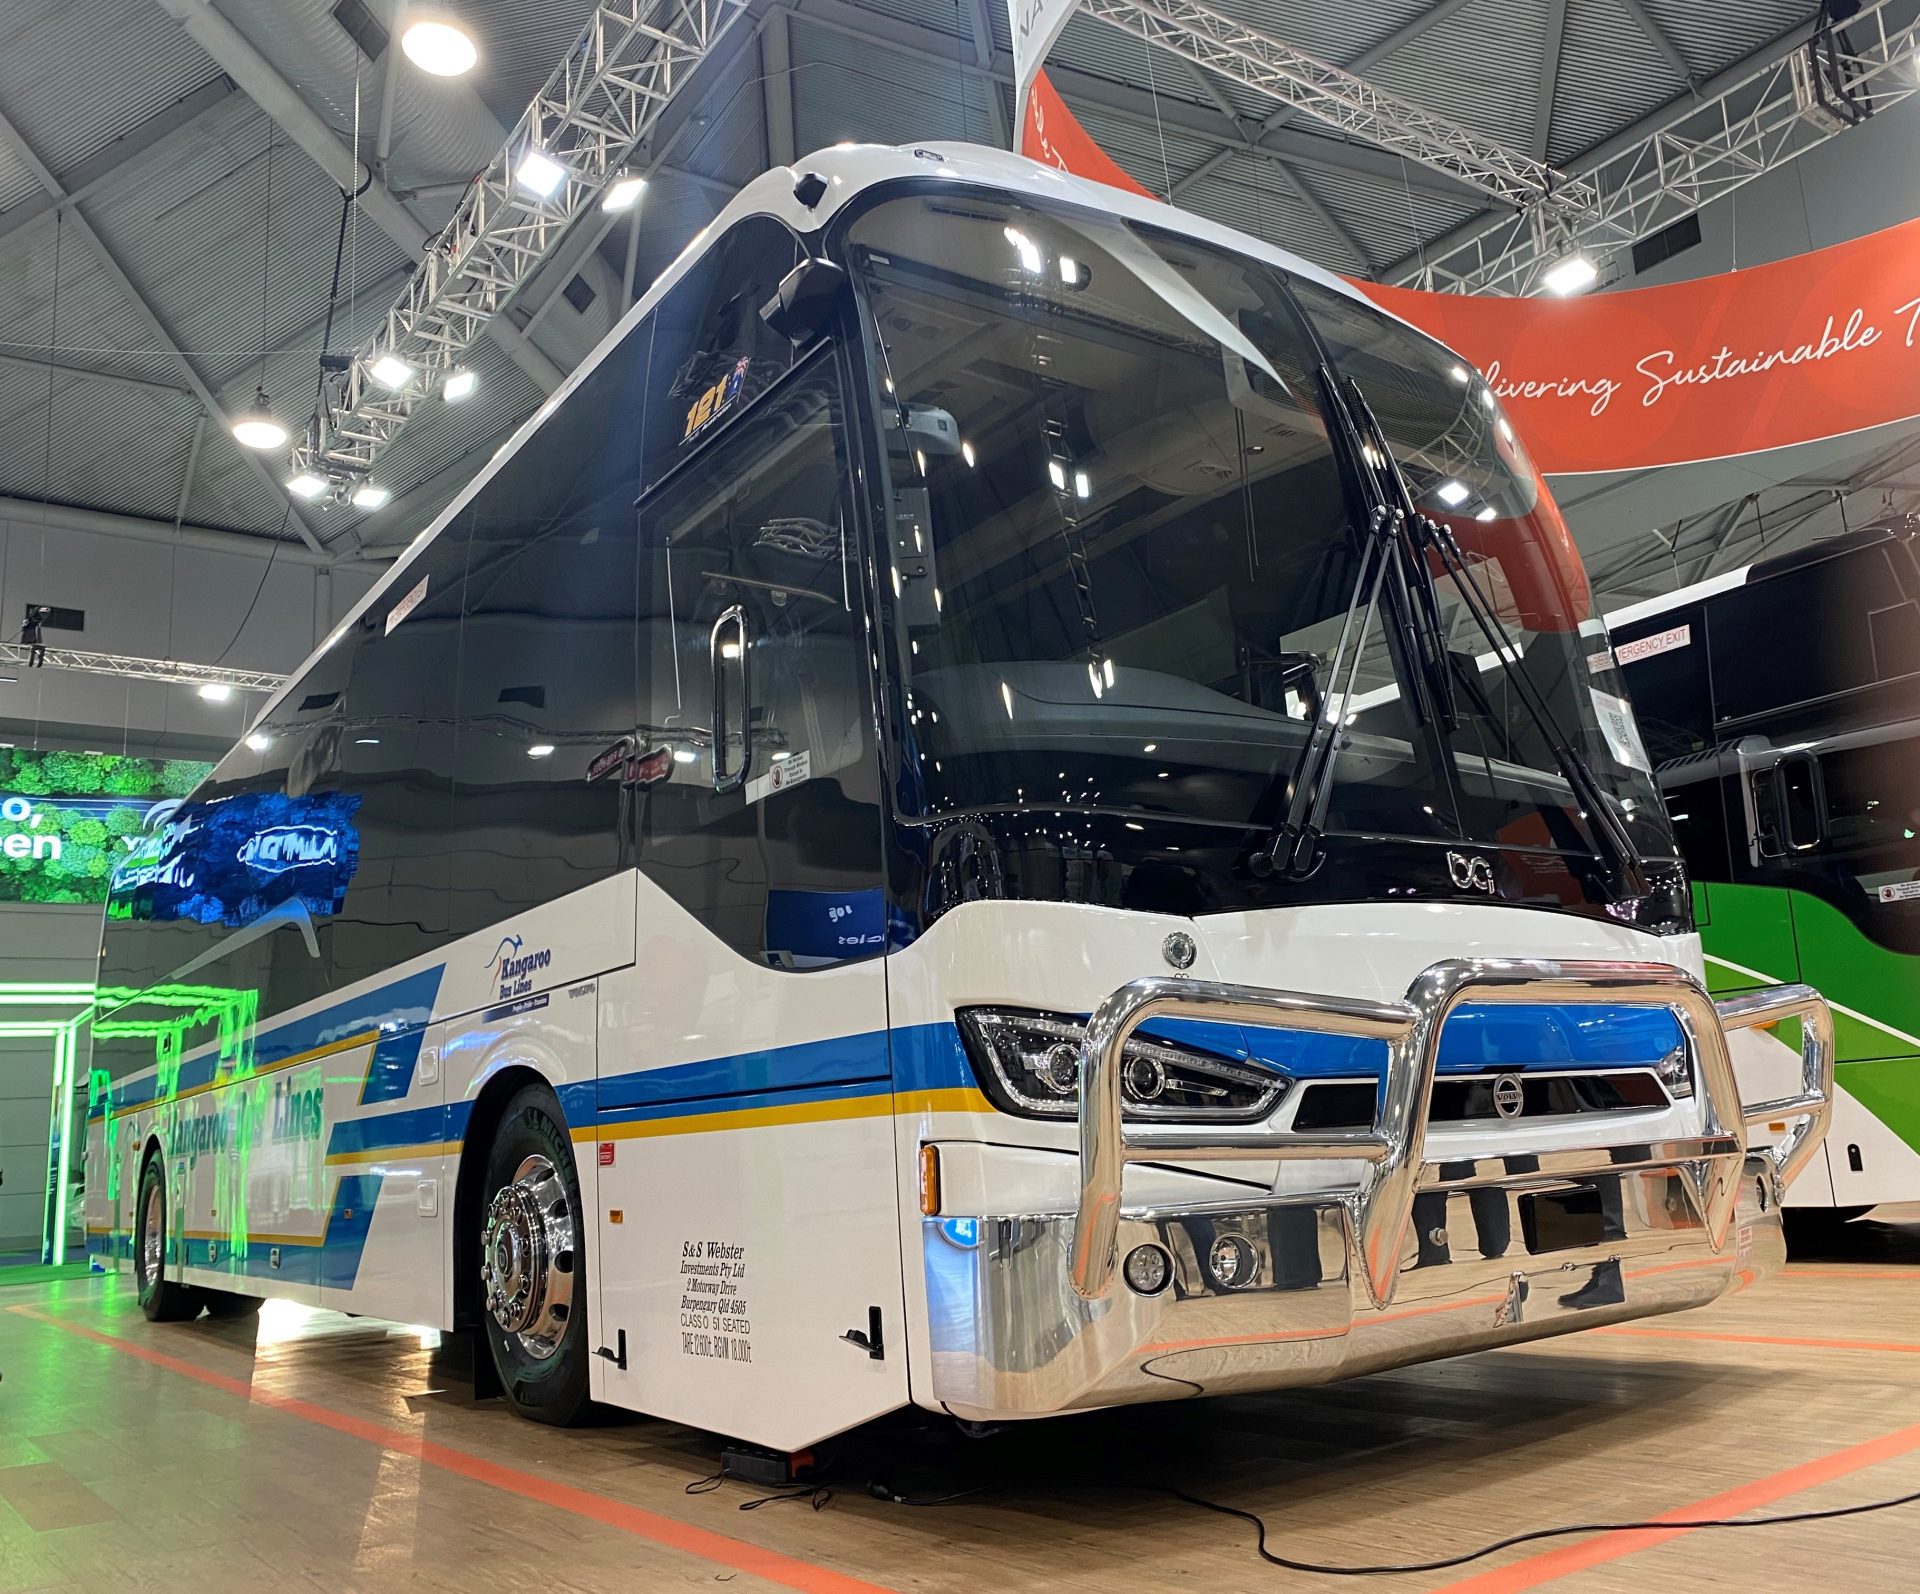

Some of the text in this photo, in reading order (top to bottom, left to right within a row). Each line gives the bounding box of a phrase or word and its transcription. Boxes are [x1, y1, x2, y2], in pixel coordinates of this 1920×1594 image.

[1636, 308, 1882, 407] Sustainable
[1618, 628, 1686, 659] ERGENCY EXIT
[0, 833, 62, 860] en
[501, 948, 551, 980] Kangaroo
[499, 978, 532, 1000] Bus Lines
[272, 1075, 324, 1143] Lines
[682, 1241, 745, 1259] S&S Webster
[680, 1260, 745, 1279] Investments Pty Ltd
[691, 1278, 720, 1296] Motorway
[720, 1280, 737, 1295] Drive
[681, 1295, 747, 1315] Burpengary Qld 4505
[681, 1313, 702, 1329] CLASS
[713, 1316, 720, 1331] 51
[723, 1317, 750, 1334] SEATED
